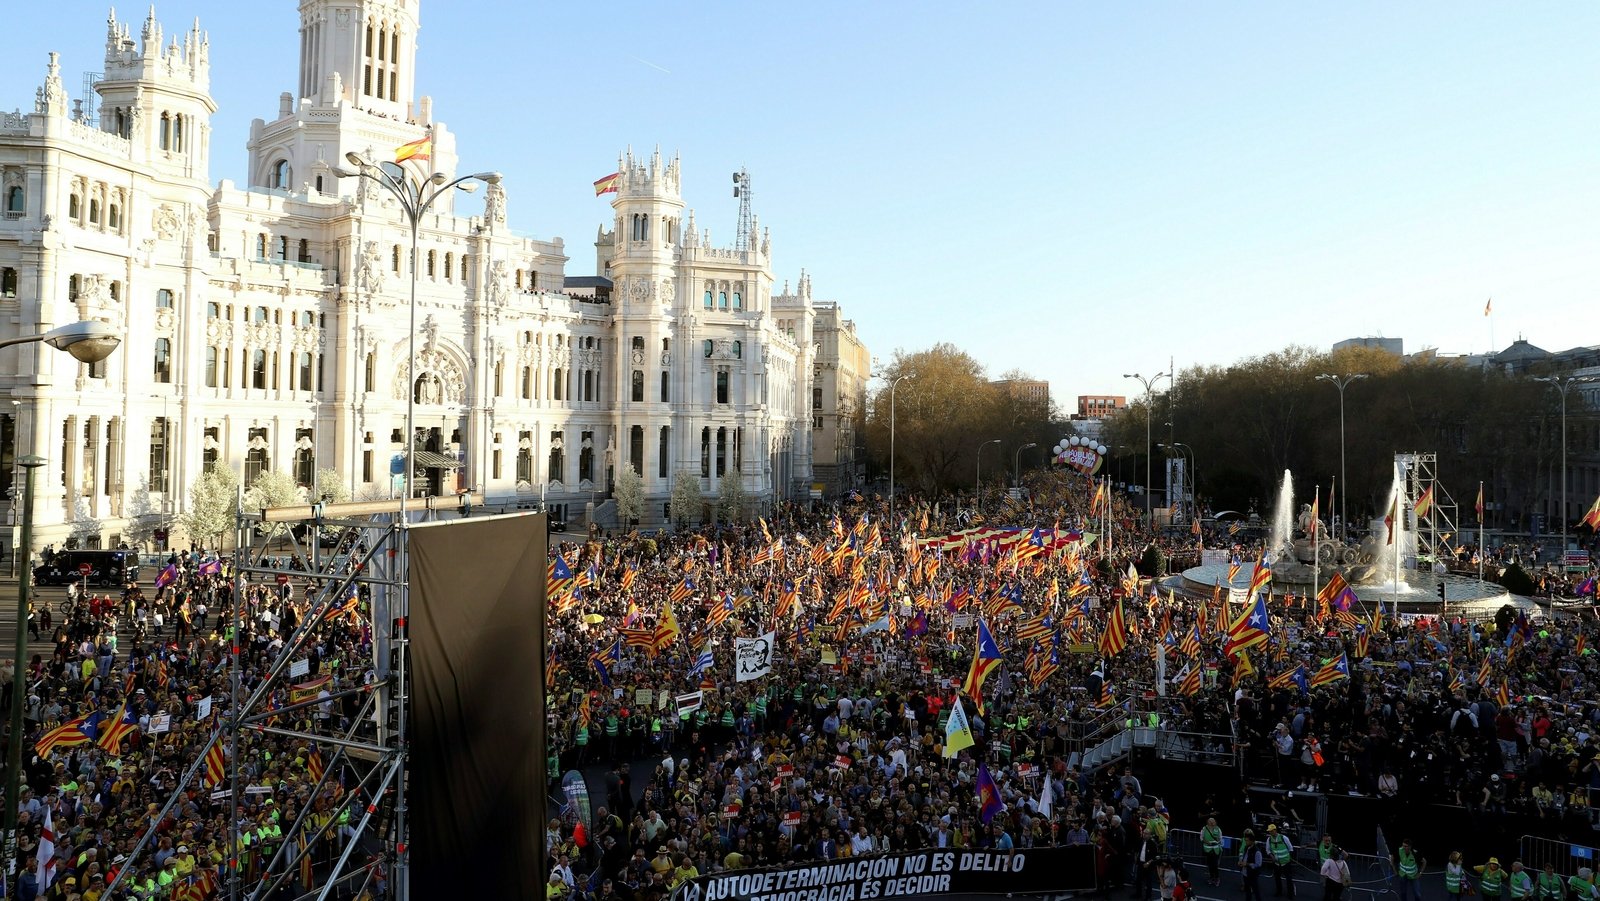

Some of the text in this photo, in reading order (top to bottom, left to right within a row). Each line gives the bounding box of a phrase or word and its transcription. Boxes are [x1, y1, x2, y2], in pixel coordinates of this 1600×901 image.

[704, 855, 899, 901] AUTODETERMINACIÓN
[902, 854, 927, 875] NO
[931, 852, 954, 872] ES
[959, 852, 1026, 873] DELITO
[750, 874, 952, 901] MOCRÀCIA ÉS DECIDIR
